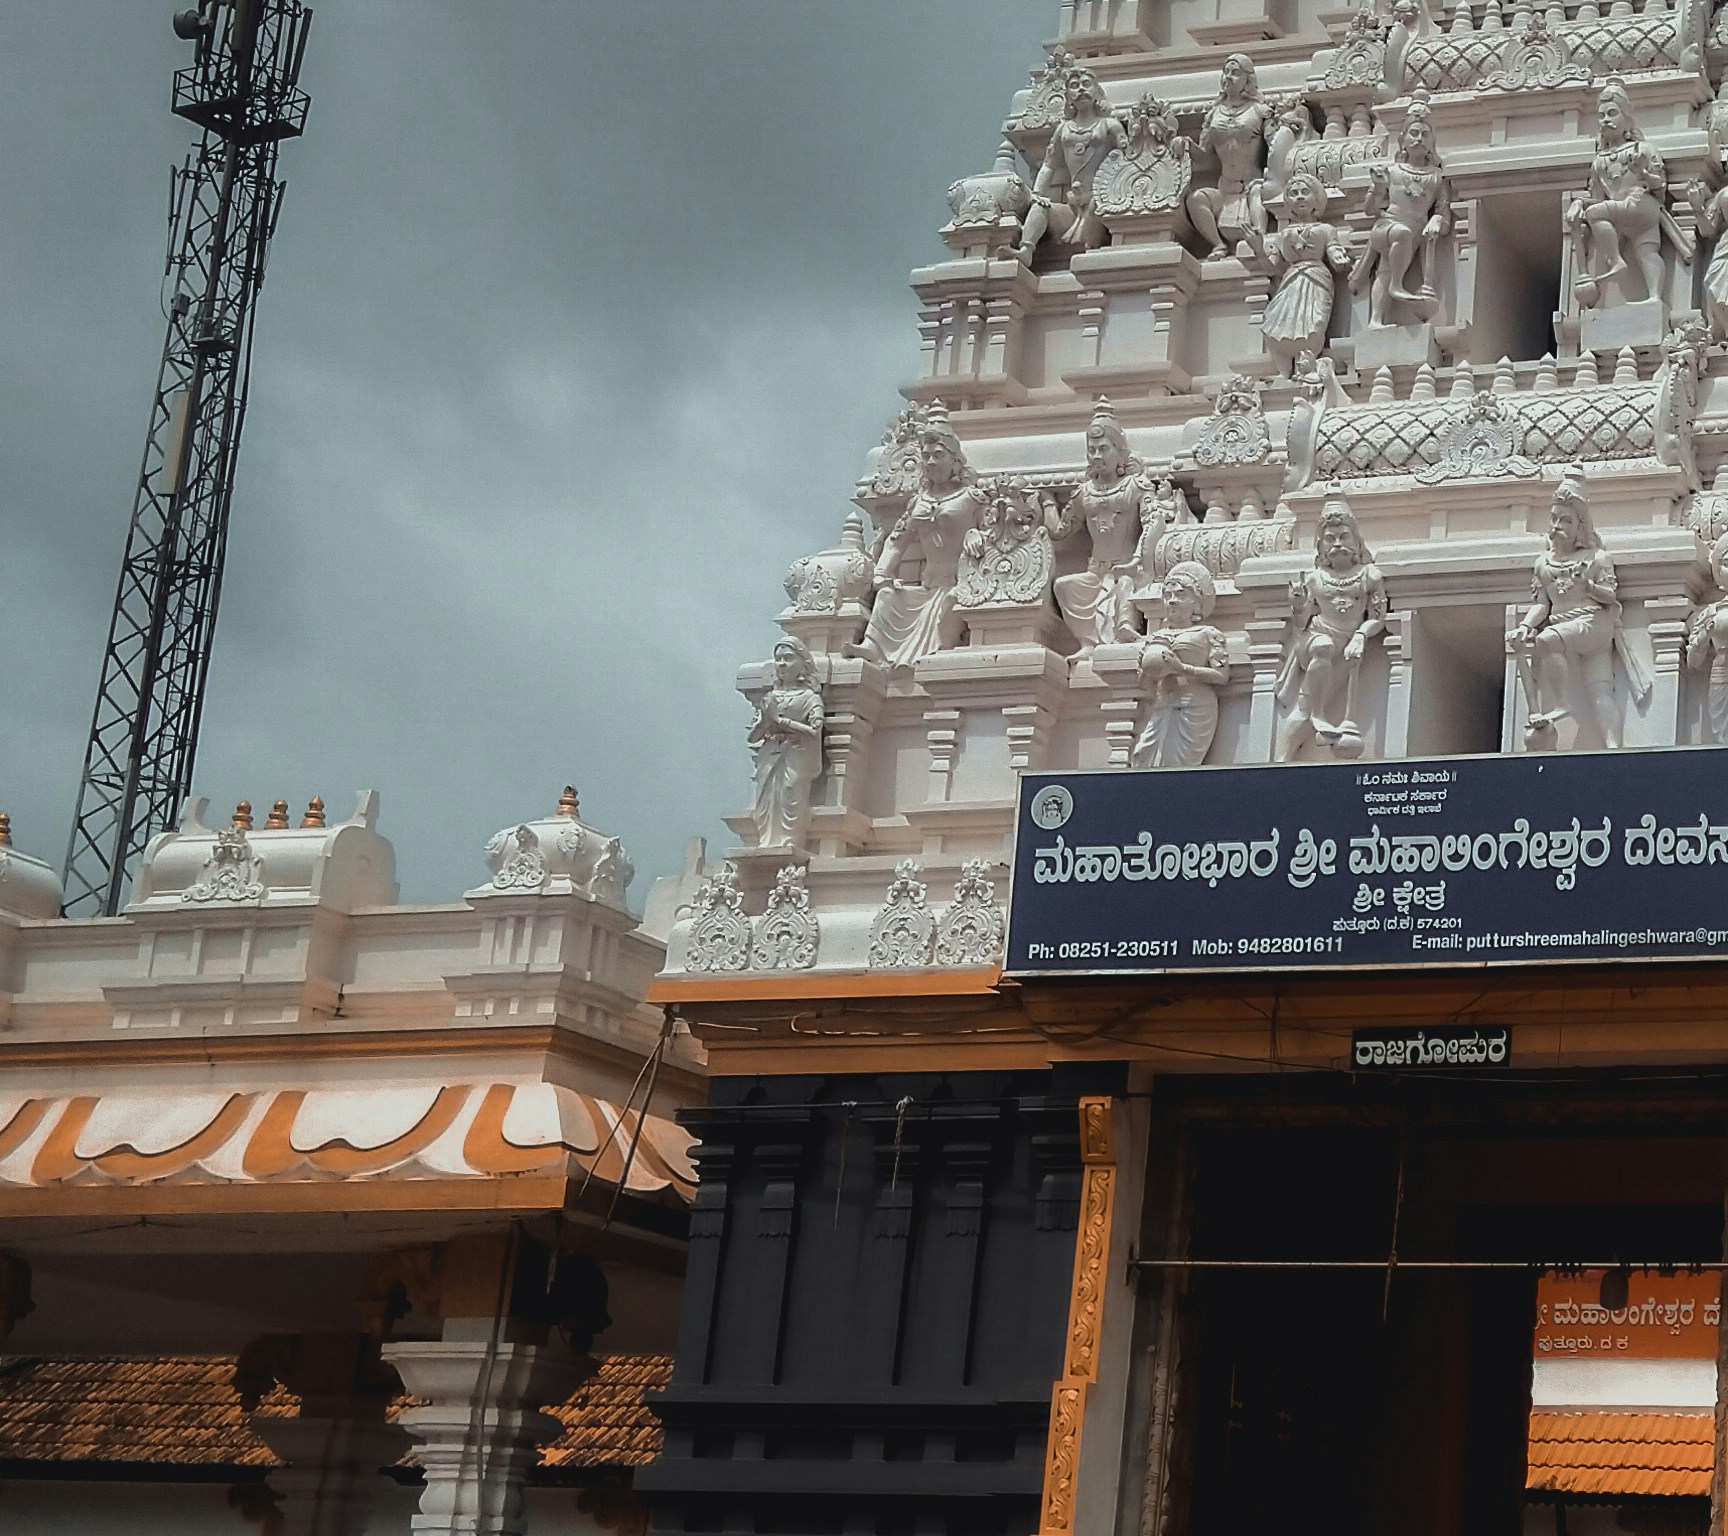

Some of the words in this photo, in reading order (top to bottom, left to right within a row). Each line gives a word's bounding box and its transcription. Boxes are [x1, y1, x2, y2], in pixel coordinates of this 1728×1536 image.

[1363, 790, 1408, 803] ಕರ್ನಾಟಕ
[1410, 788, 1448, 801] ಸರ್ಕಾರ
[1033, 824, 1280, 888] ಮಹಾತೋಭಾರ
[1287, 828, 1337, 889] ಶ್ರೀ
[1348, 814, 1612, 892] ಮಹಾಲಿಂಗೇಶ್ವರ
[1352, 883, 1385, 913] ಶ್ರೀ
[1392, 879, 1446, 915] ಕ್ಷೇತ್ರ
[1332, 916, 1381, 935] ಪುತ್ತೂರು
[1416, 917, 1462, 929] 574201
[1028, 943, 1055, 959] Ph:
[1058, 940, 1178, 959] 08251-230511
[1192, 938, 1233, 955] Mob:
[1237, 936, 1343, 954] 9482801611
[1412, 933, 1463, 949] E-mail:
[1355, 1030, 1507, 1065] ರಾಜಗೋಪುರ
